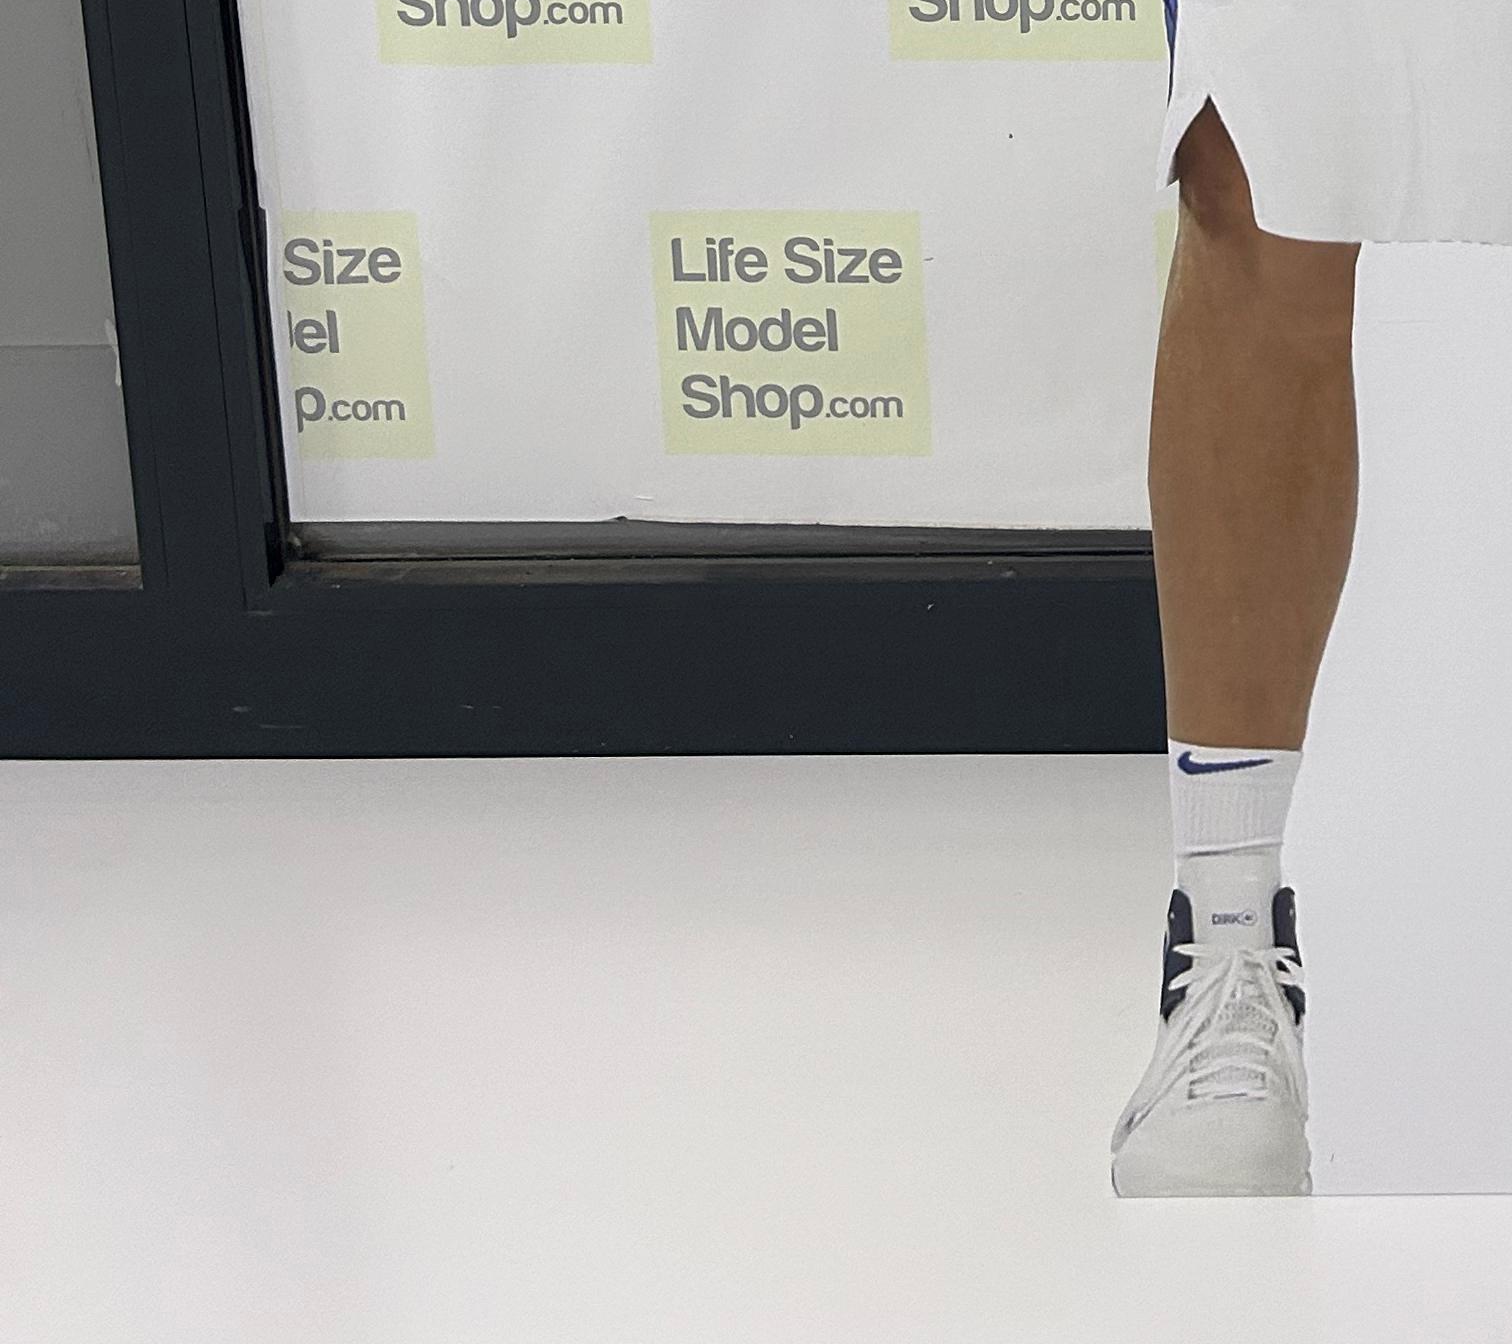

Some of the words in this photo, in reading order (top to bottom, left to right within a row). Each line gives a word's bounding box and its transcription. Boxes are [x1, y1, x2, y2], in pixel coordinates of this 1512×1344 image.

[283, 238, 401, 285] Size
[671, 237, 768, 283] Life
[784, 237, 902, 284] Size
[287, 310, 340, 354] el
[676, 307, 838, 352] Model
[682, 374, 903, 430] Shop.com
